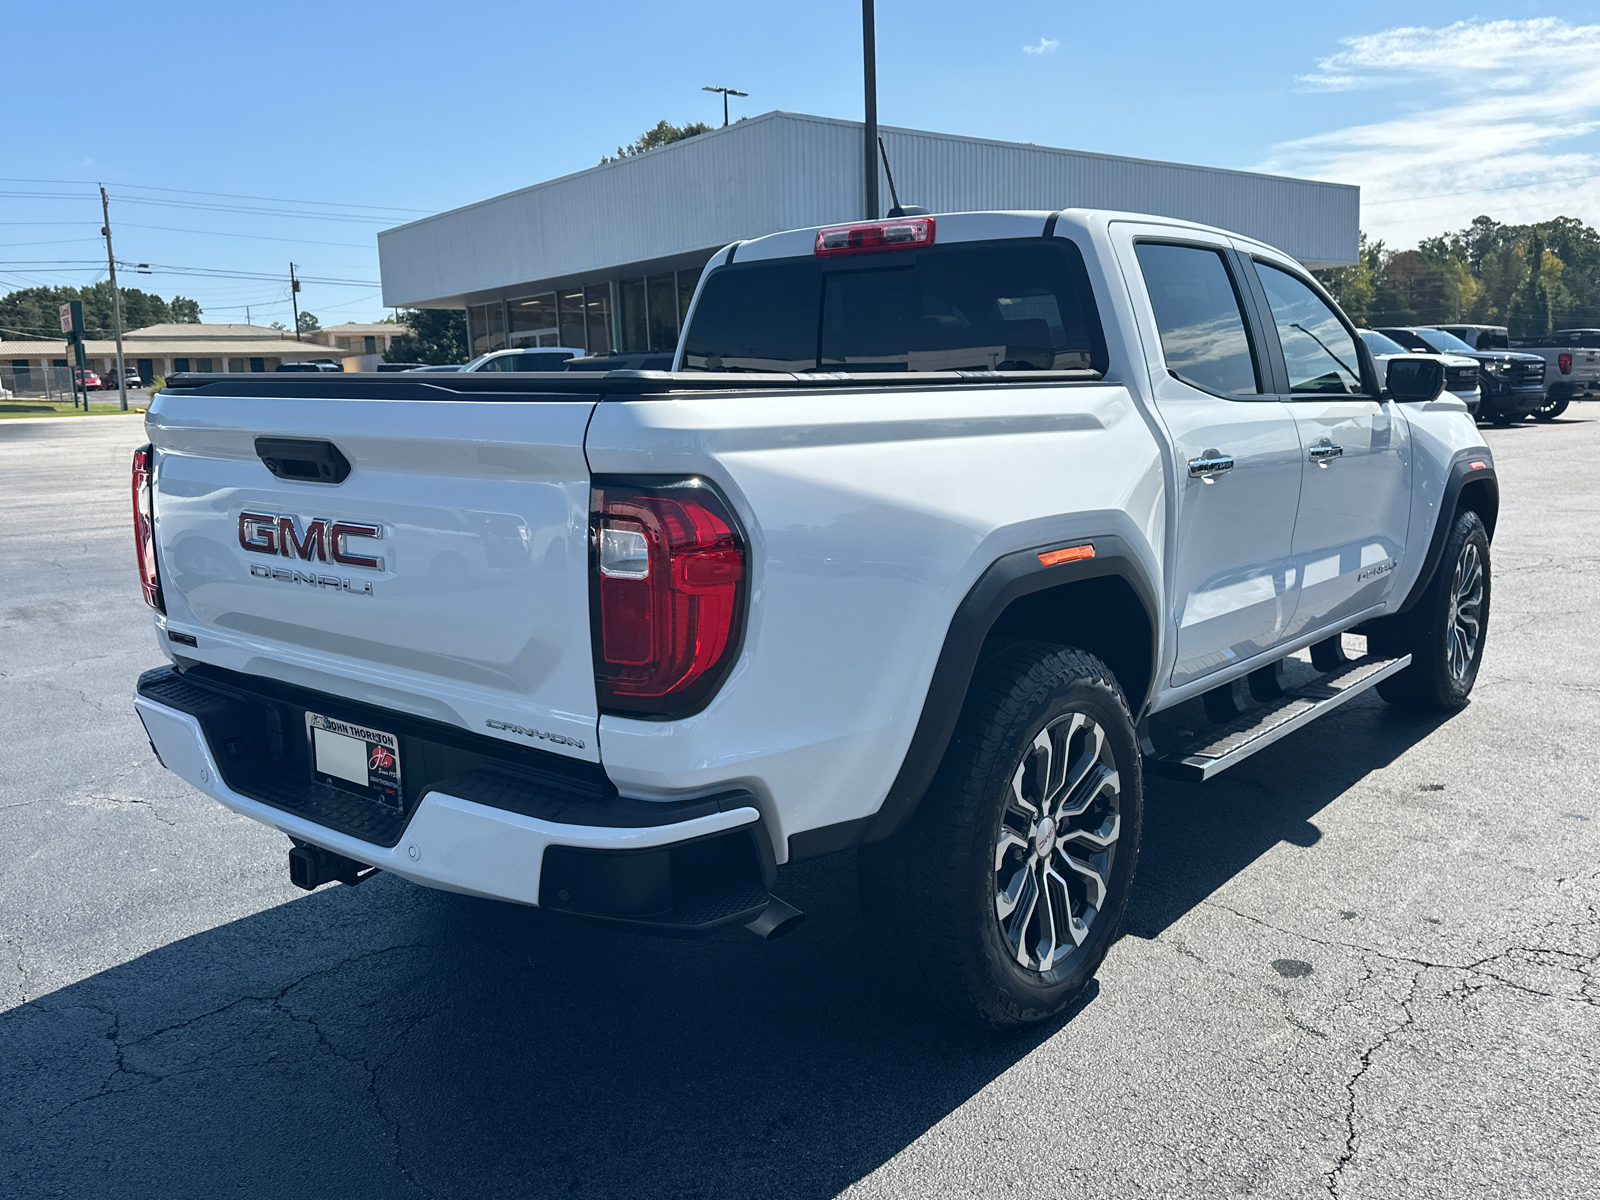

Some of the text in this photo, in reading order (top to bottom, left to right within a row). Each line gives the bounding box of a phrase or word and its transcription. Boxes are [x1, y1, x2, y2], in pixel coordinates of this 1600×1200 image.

[238, 509, 385, 572] GMC
[250, 562, 374, 596] DENALI
[1357, 560, 1398, 582] DENALI
[349, 726, 394, 747] THORNTON
[485, 718, 586, 750] CANYON
[1038, 825, 1056, 850] GMC
